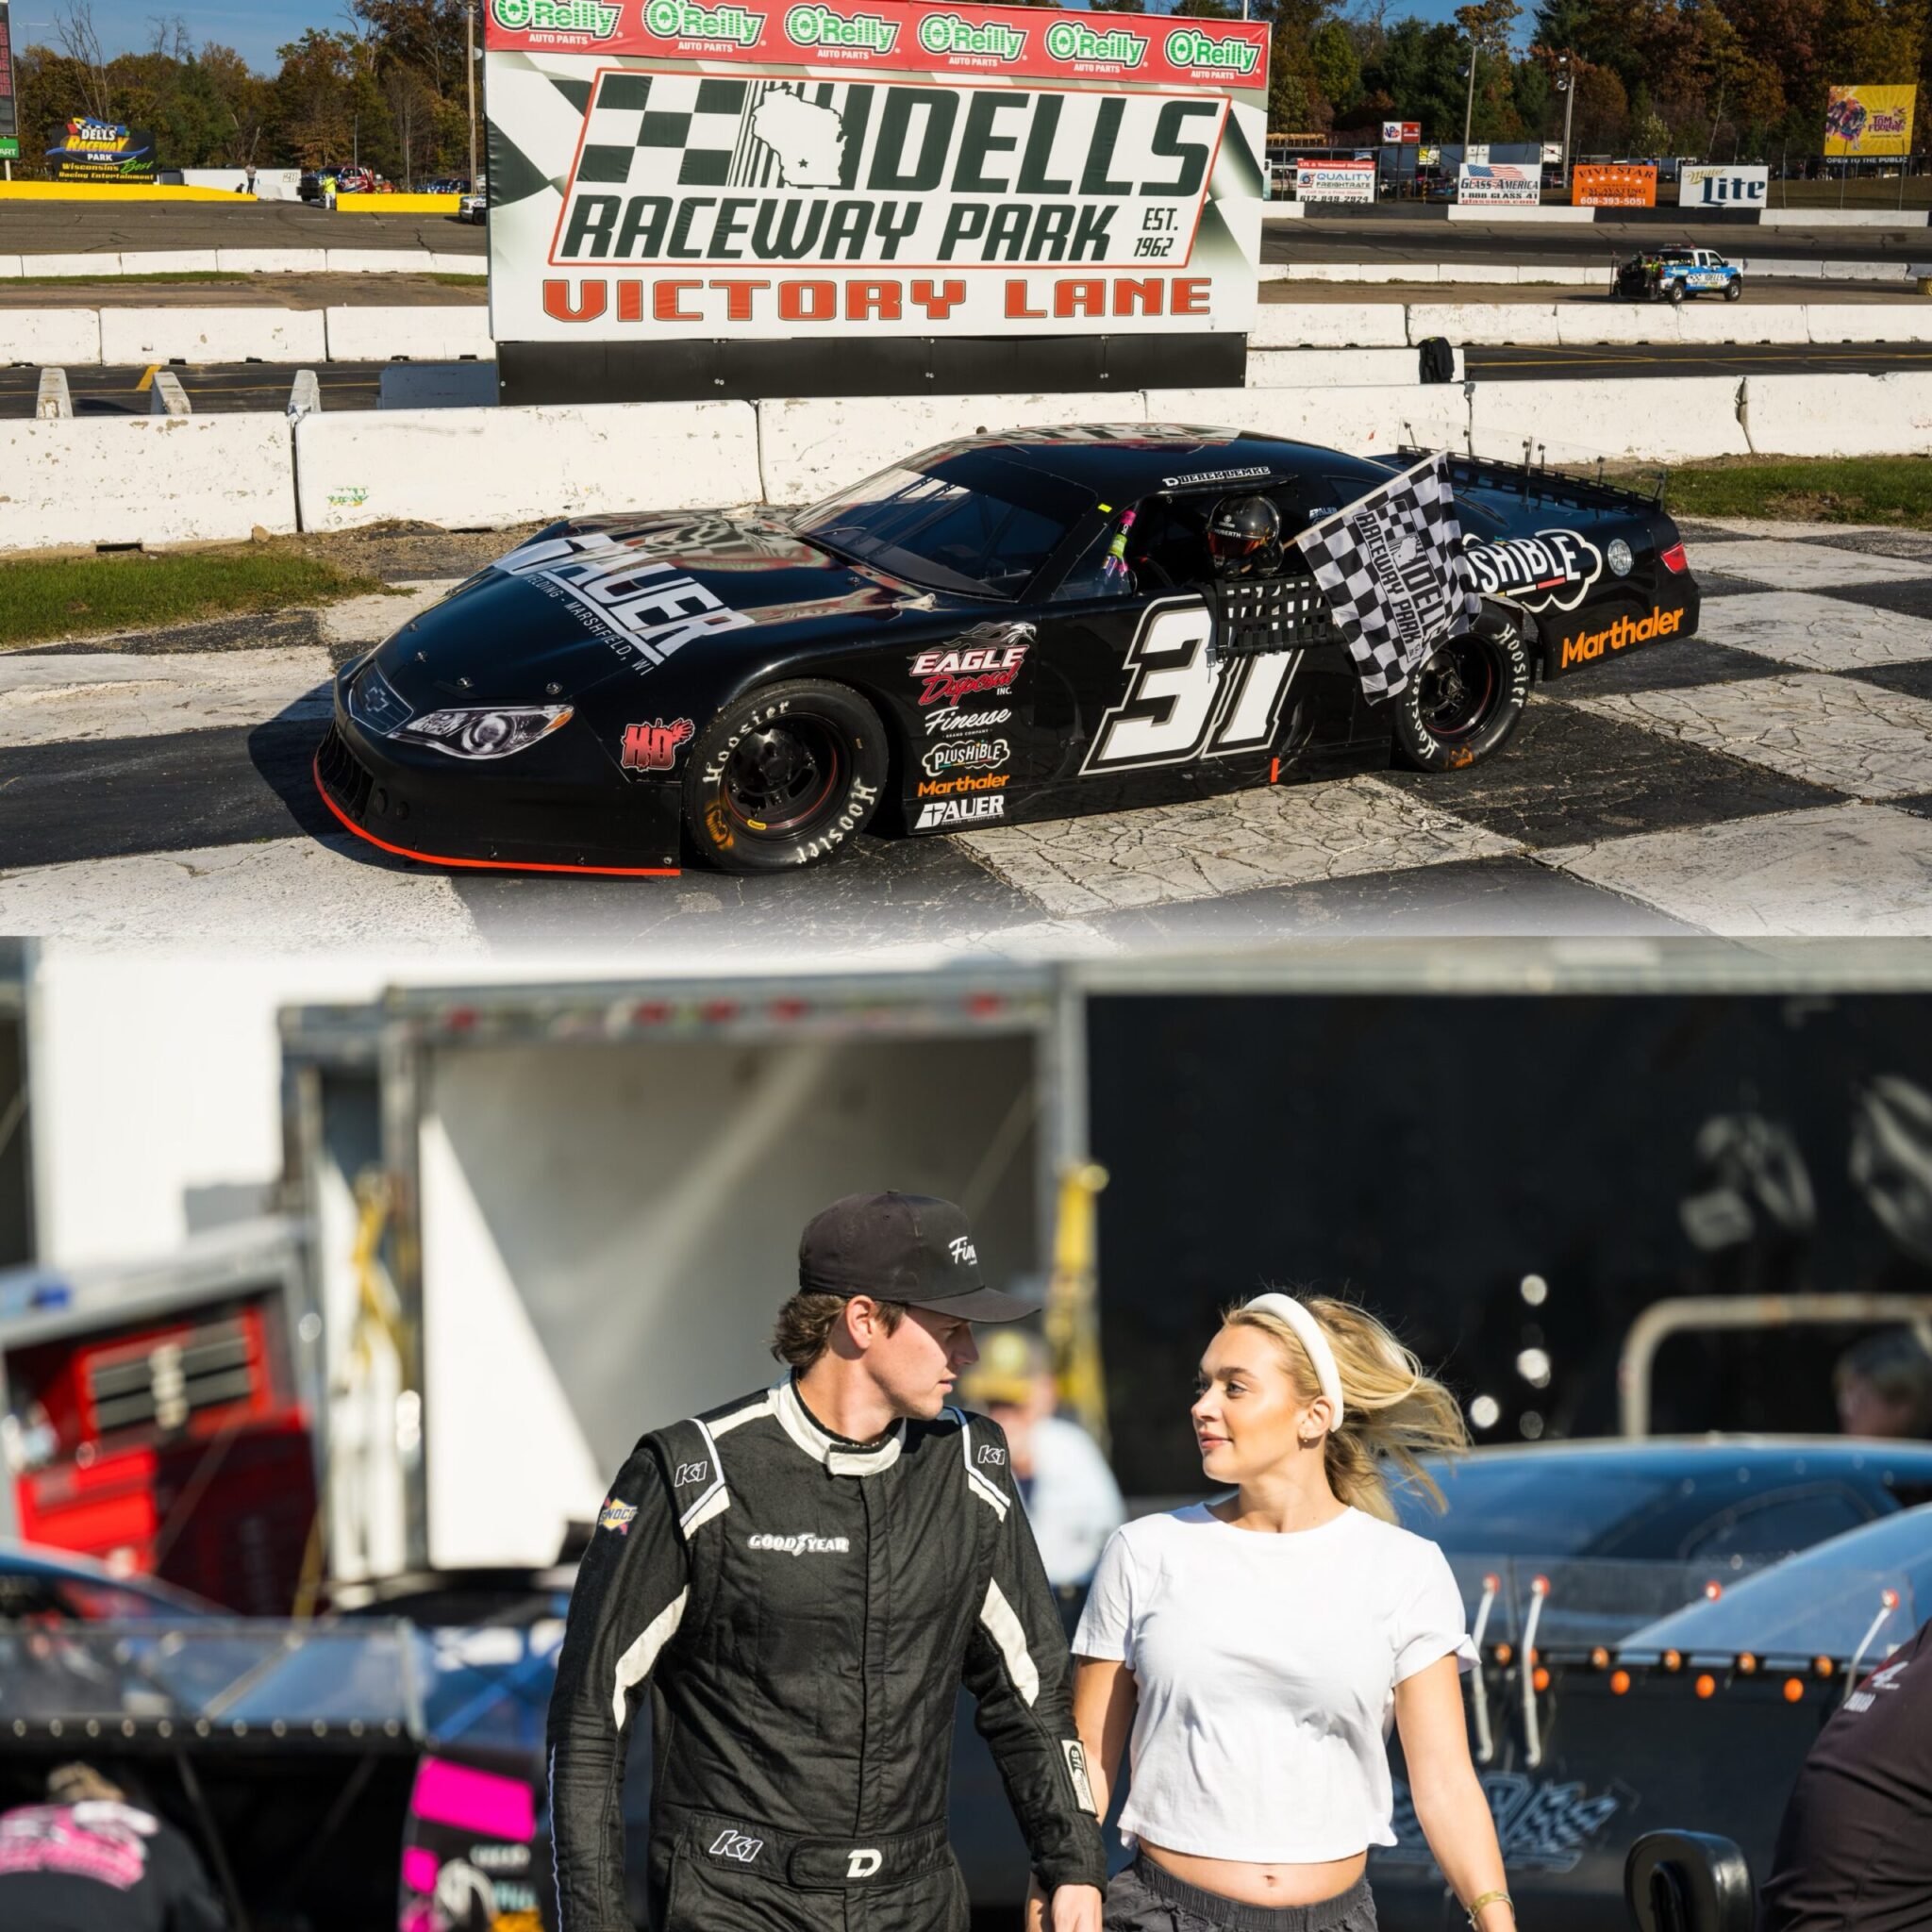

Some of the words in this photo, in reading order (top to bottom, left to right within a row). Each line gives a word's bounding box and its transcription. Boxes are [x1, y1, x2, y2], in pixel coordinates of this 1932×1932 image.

[496, 0, 614, 34] OReilly
[649, 0, 758, 42] O'Reilly
[791, 9, 892, 49] O'Reilly
[529, 33, 555, 43] AUTO
[557, 35, 588, 44] PARTS
[678, 42, 702, 51] AUTO
[704, 42, 733, 53] PARTS
[924, 18, 1021, 58] O'Reilly
[1051, 26, 1142, 64] O'Reilly
[1170, 34, 1255, 70] O'Reilly
[818, 49, 841, 58] AUTO
[841, 51, 869, 59] PARTS
[948, 57, 971, 65] AUTO
[972, 58, 998, 67] PARTS
[1095, 65, 1121, 74] PARTS
[65, 135, 129, 152] RACEWAY
[81, 128, 117, 141] DELLS
[866, 87, 1220, 197] DELLS
[87, 153, 113, 161] PARK
[120, 159, 154, 174] Best
[92, 172, 155, 180] Entertainment
[1317, 172, 1373, 181] QUALITY
[1578, 166, 1612, 178] FIVE
[1616, 166, 1654, 179] STAR
[1683, 168, 1726, 184] Miller
[1580, 196, 1646, 205] 608-393-5051
[1699, 176, 1766, 206] Lite
[560, 194, 924, 260] RACEWAY
[937, 202, 1120, 261] PARK
[1141, 208, 1179, 232] EST.
[1133, 237, 1174, 258] 1962
[542, 278, 966, 323] VICTORY
[1005, 278, 1212, 319] LANE
[1177, 471, 1225, 485] DEREK
[1224, 465, 1272, 479] LEMKE
[1357, 511, 1405, 595] RACEWAY
[1464, 536, 1581, 594] SHIBLE
[1391, 599, 1422, 644] PARK
[1560, 606, 1685, 669] Marthaler
[632, 658, 656, 676] WI
[910, 645, 1029, 675] EAGLE
[1492, 623, 1530, 708] Hoosier
[919, 660, 1024, 706] Disposal
[996, 687, 1012, 696] INC.
[1079, 582, 1317, 777] 31
[924, 706, 1012, 736] Finesse
[702, 700, 791, 788] Hoosier
[917, 772, 1010, 798] Marthaler
[795, 775, 878, 865] Hoosier
[913, 794, 1005, 830] BAUER
[977, 1444, 1006, 1466] K1
[674, 1460, 708, 1488] K1
[747, 1532, 850, 1557] GOODYEAR
[708, 1829, 764, 1863] K1
[845, 1848, 883, 1878] D
